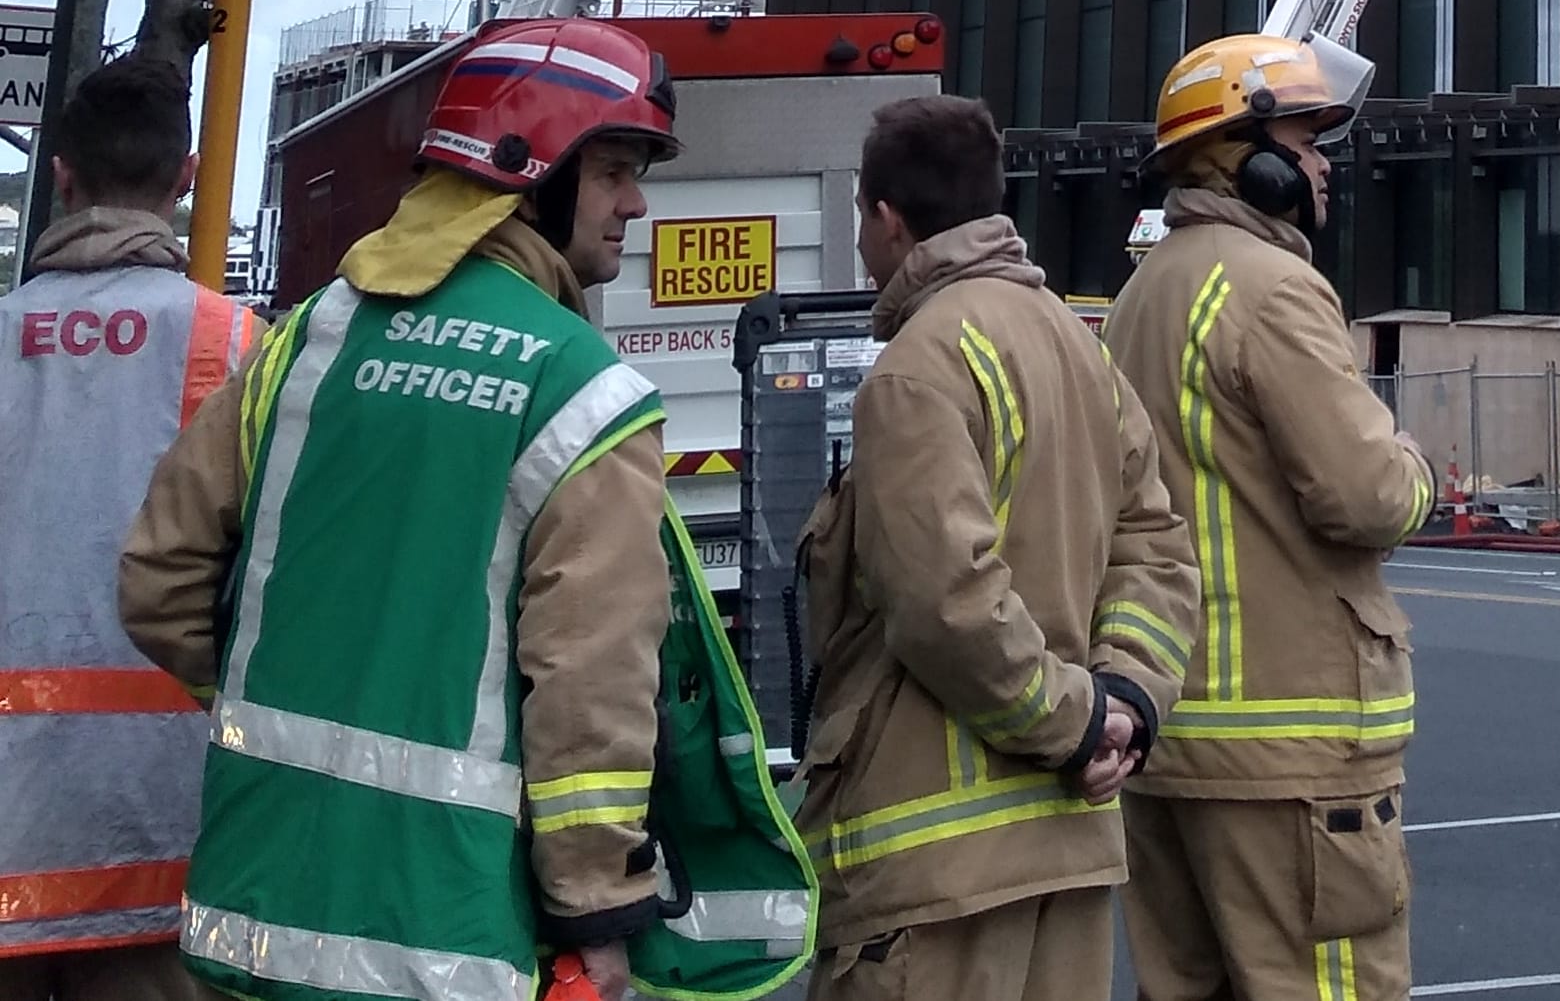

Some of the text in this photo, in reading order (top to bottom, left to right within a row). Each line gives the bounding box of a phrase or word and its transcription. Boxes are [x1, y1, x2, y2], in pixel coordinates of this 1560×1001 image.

[212, 9, 227, 33] 2
[1338, 14, 1356, 46] ONTO
[678, 226, 751, 262] FIRE
[661, 263, 768, 296] RESCUE
[21, 309, 148, 358] ECO
[385, 311, 552, 363] SAFETY
[617, 328, 731, 354] KEEP BACK 5
[354, 359, 530, 415] OFFICER
